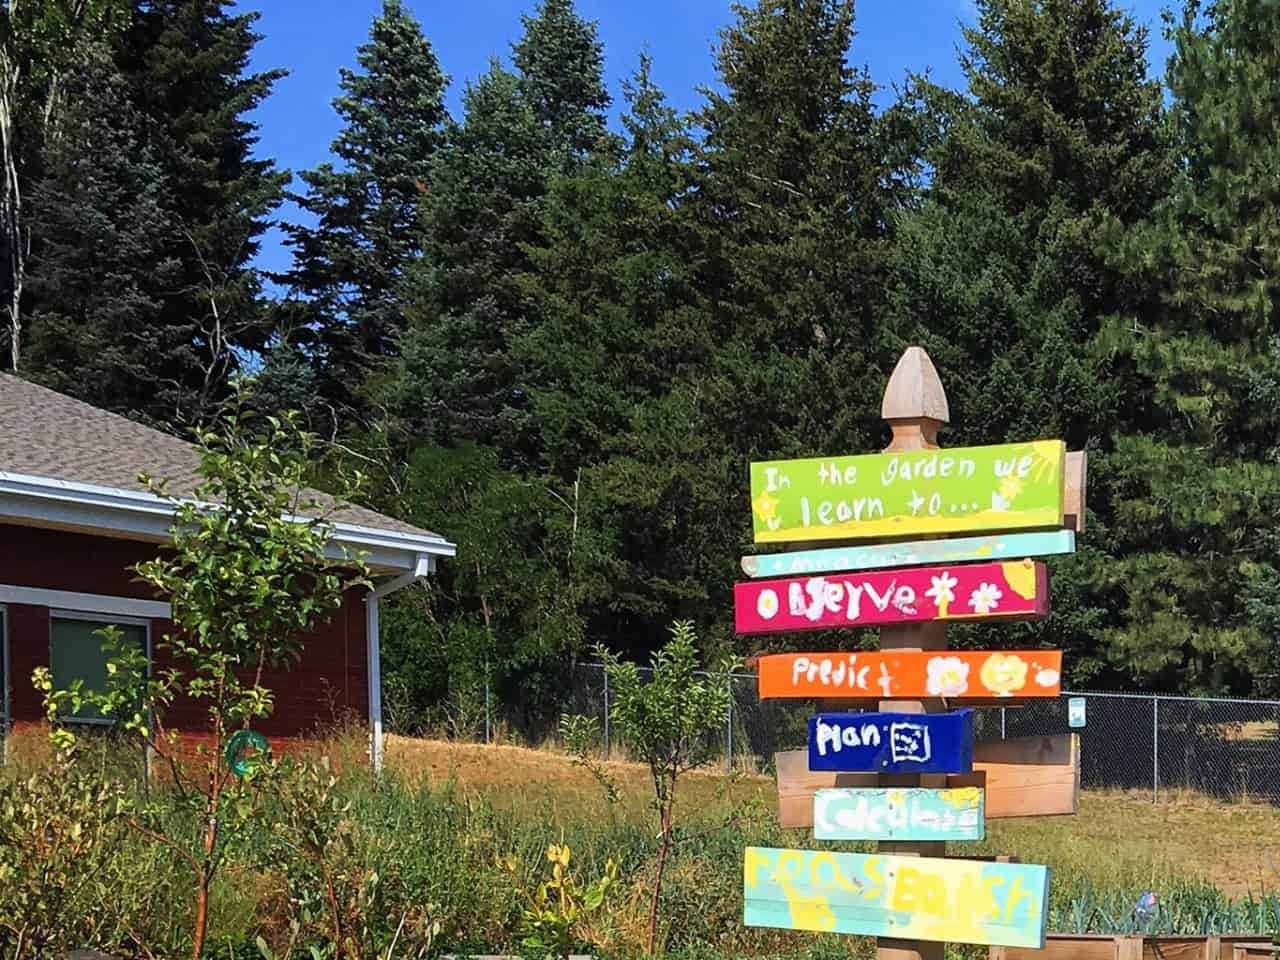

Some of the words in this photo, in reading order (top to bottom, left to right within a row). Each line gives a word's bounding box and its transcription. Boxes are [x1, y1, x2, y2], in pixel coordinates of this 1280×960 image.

[764, 467, 790, 492] In
[818, 461, 857, 485] the
[881, 454, 975, 487] garden
[994, 455, 1033, 478] we
[800, 495, 884, 526] learn
[816, 717, 881, 756] Plan
